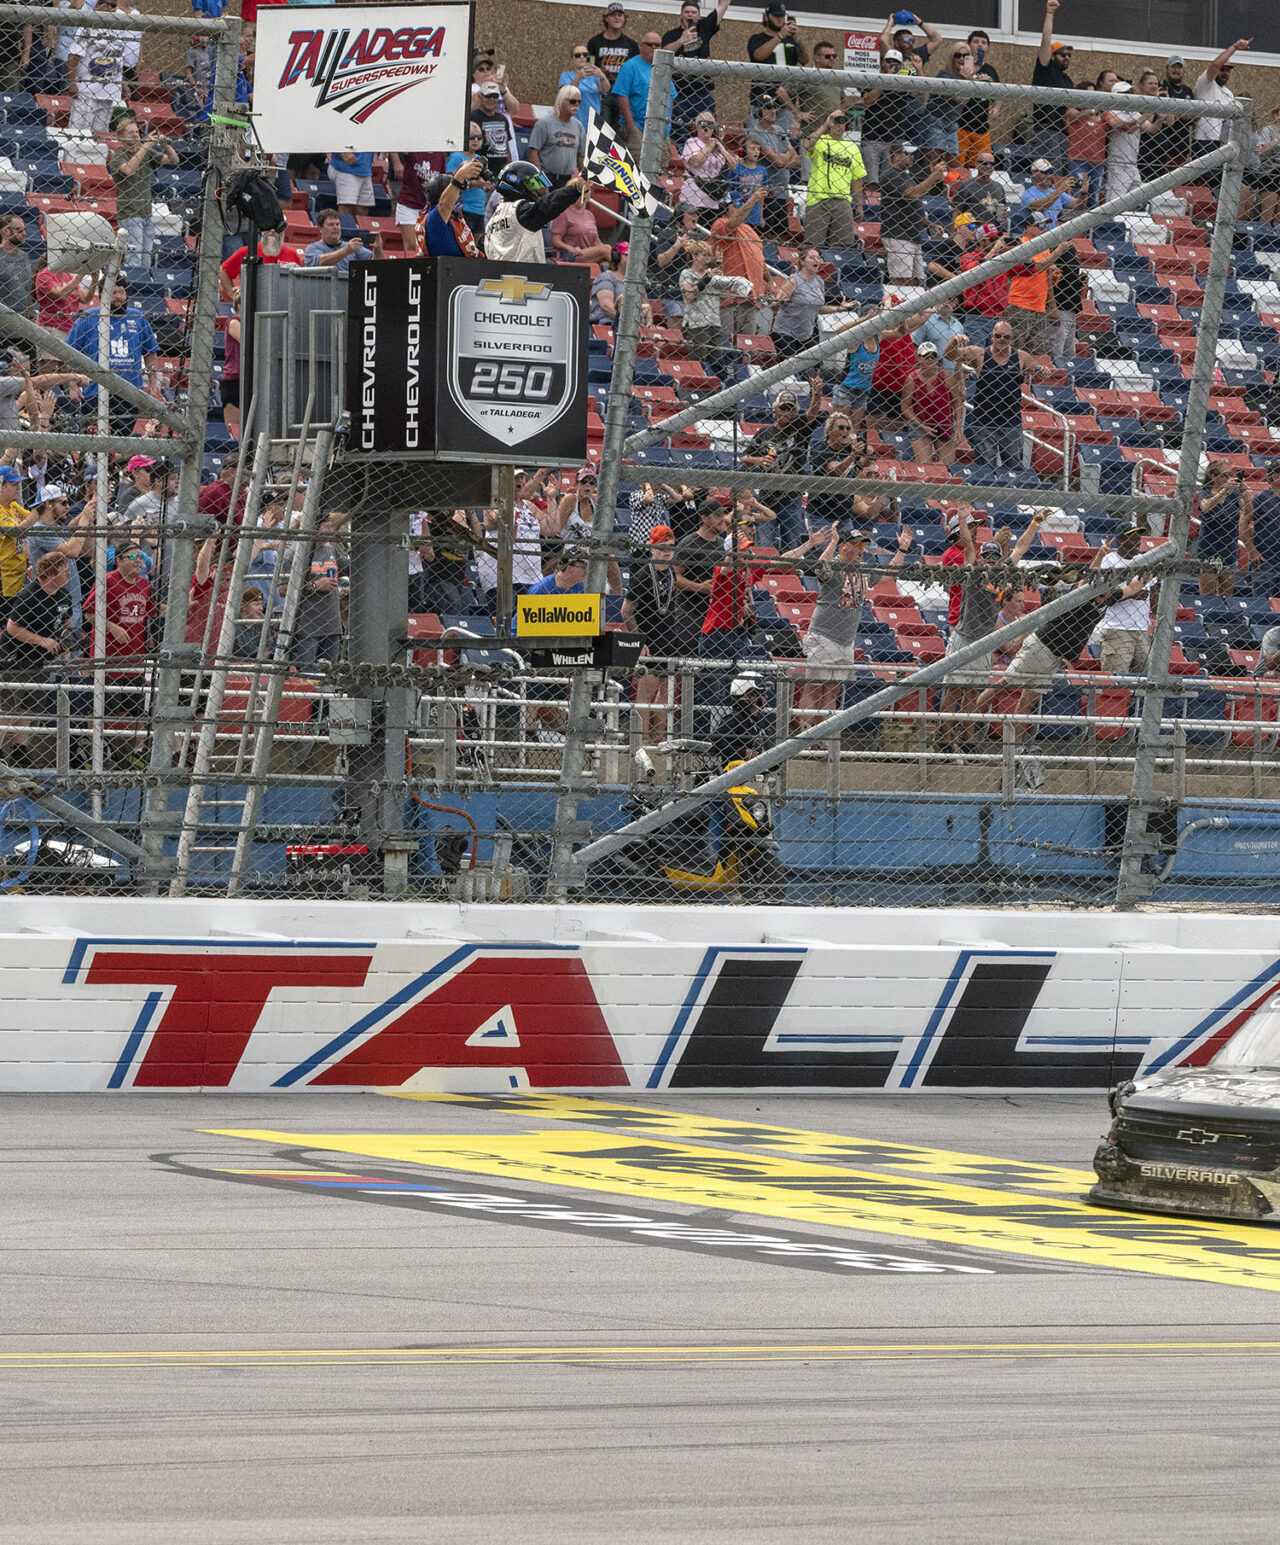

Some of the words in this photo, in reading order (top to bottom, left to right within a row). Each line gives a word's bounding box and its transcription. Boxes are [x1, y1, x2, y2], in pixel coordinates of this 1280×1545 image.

[278, 26, 446, 108] TALLADEGA
[330, 64, 438, 93] SUPERSPEEDWAY
[601, 157, 640, 201] SUNOCO
[474, 311, 553, 327] CHEVROLET
[361, 269, 378, 449] CHEVROLET
[406, 267, 422, 448] CHEVROLET
[473, 340, 553, 353] SILVERADO
[469, 362, 553, 399] 250
[489, 408, 542, 419] TALLADEGA
[522, 606, 593, 624] YellaWood
[552, 652, 594, 665] WHELEN
[617, 640, 640, 648] WHELEN
[357, 1190, 996, 1274] PLAYOFFS
